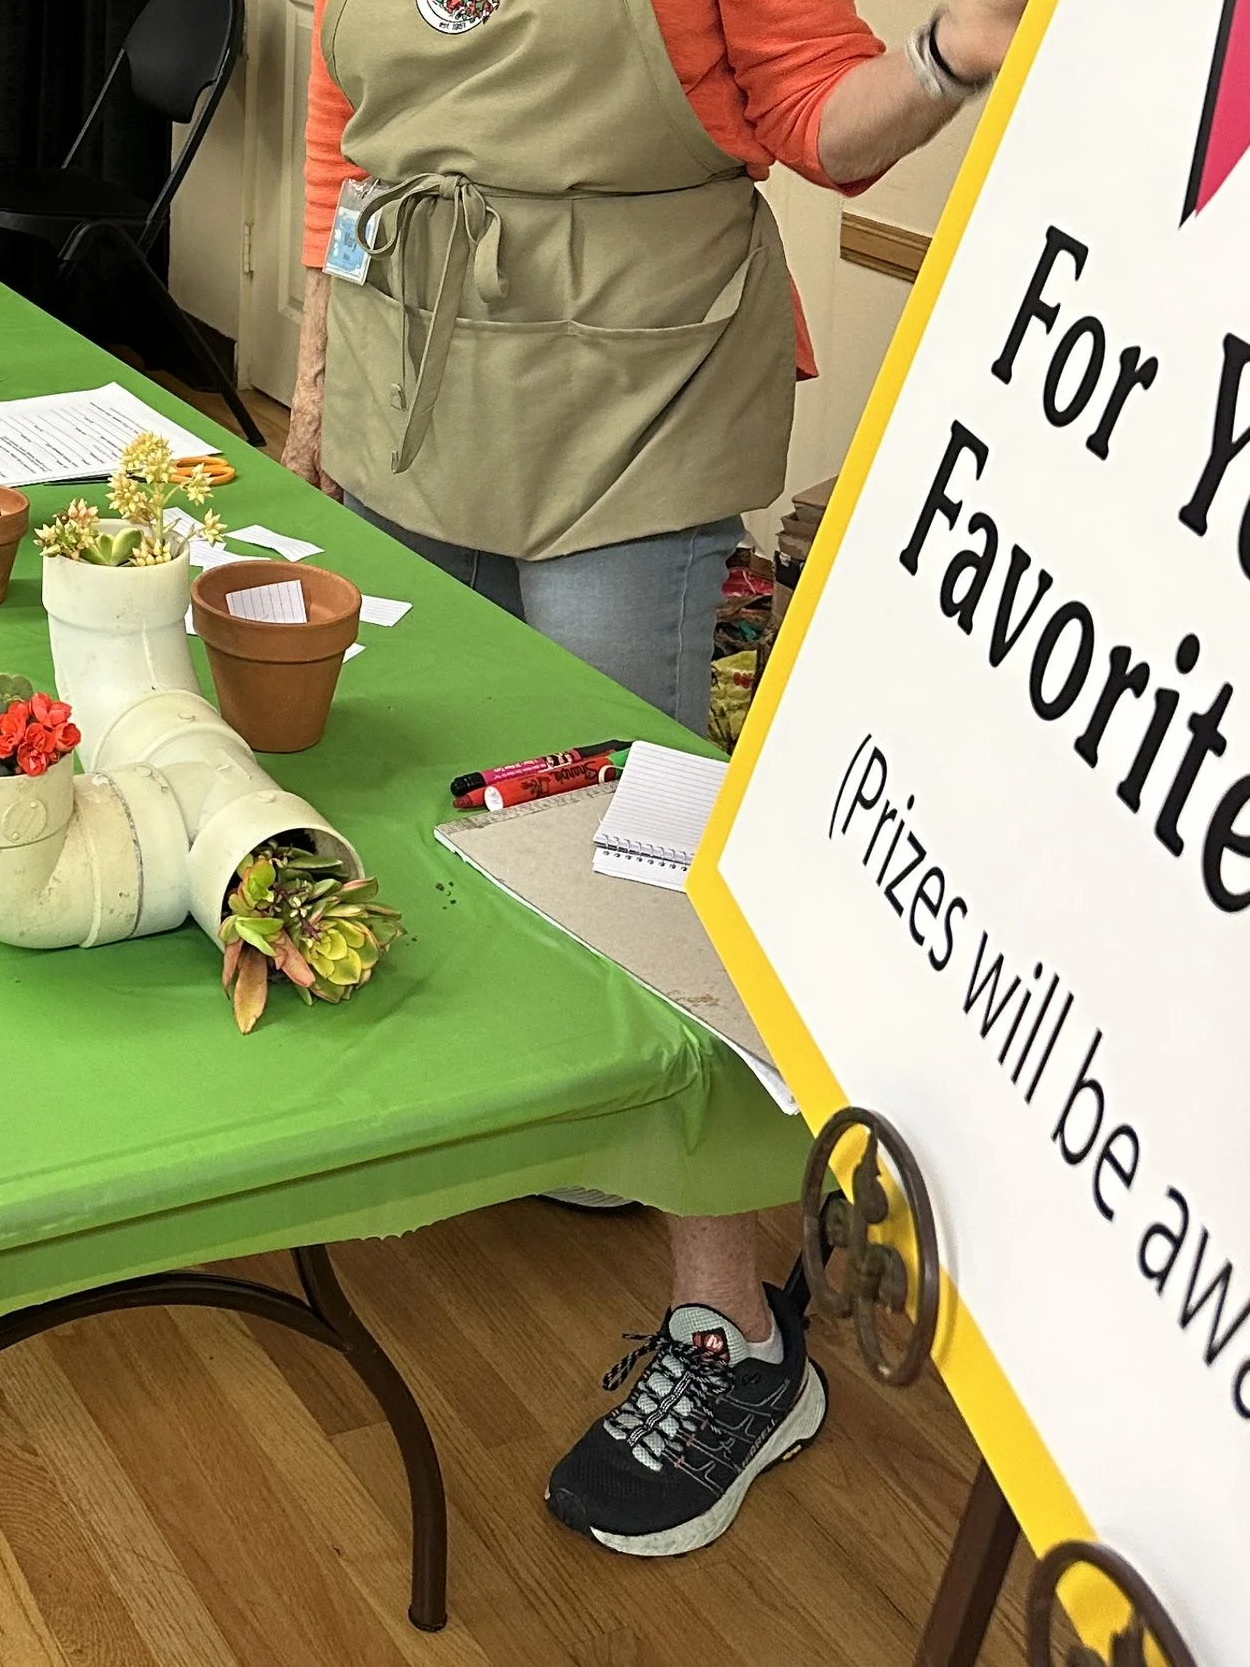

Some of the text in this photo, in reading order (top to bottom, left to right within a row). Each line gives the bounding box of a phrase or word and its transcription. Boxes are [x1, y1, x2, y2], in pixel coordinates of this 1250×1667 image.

[991, 225, 1250, 580] For Y
[899, 419, 1250, 913] Favorite
[828, 733, 968, 972] (Prizes
[963, 931, 1074, 1104] will
[1052, 1030, 1140, 1221] be
